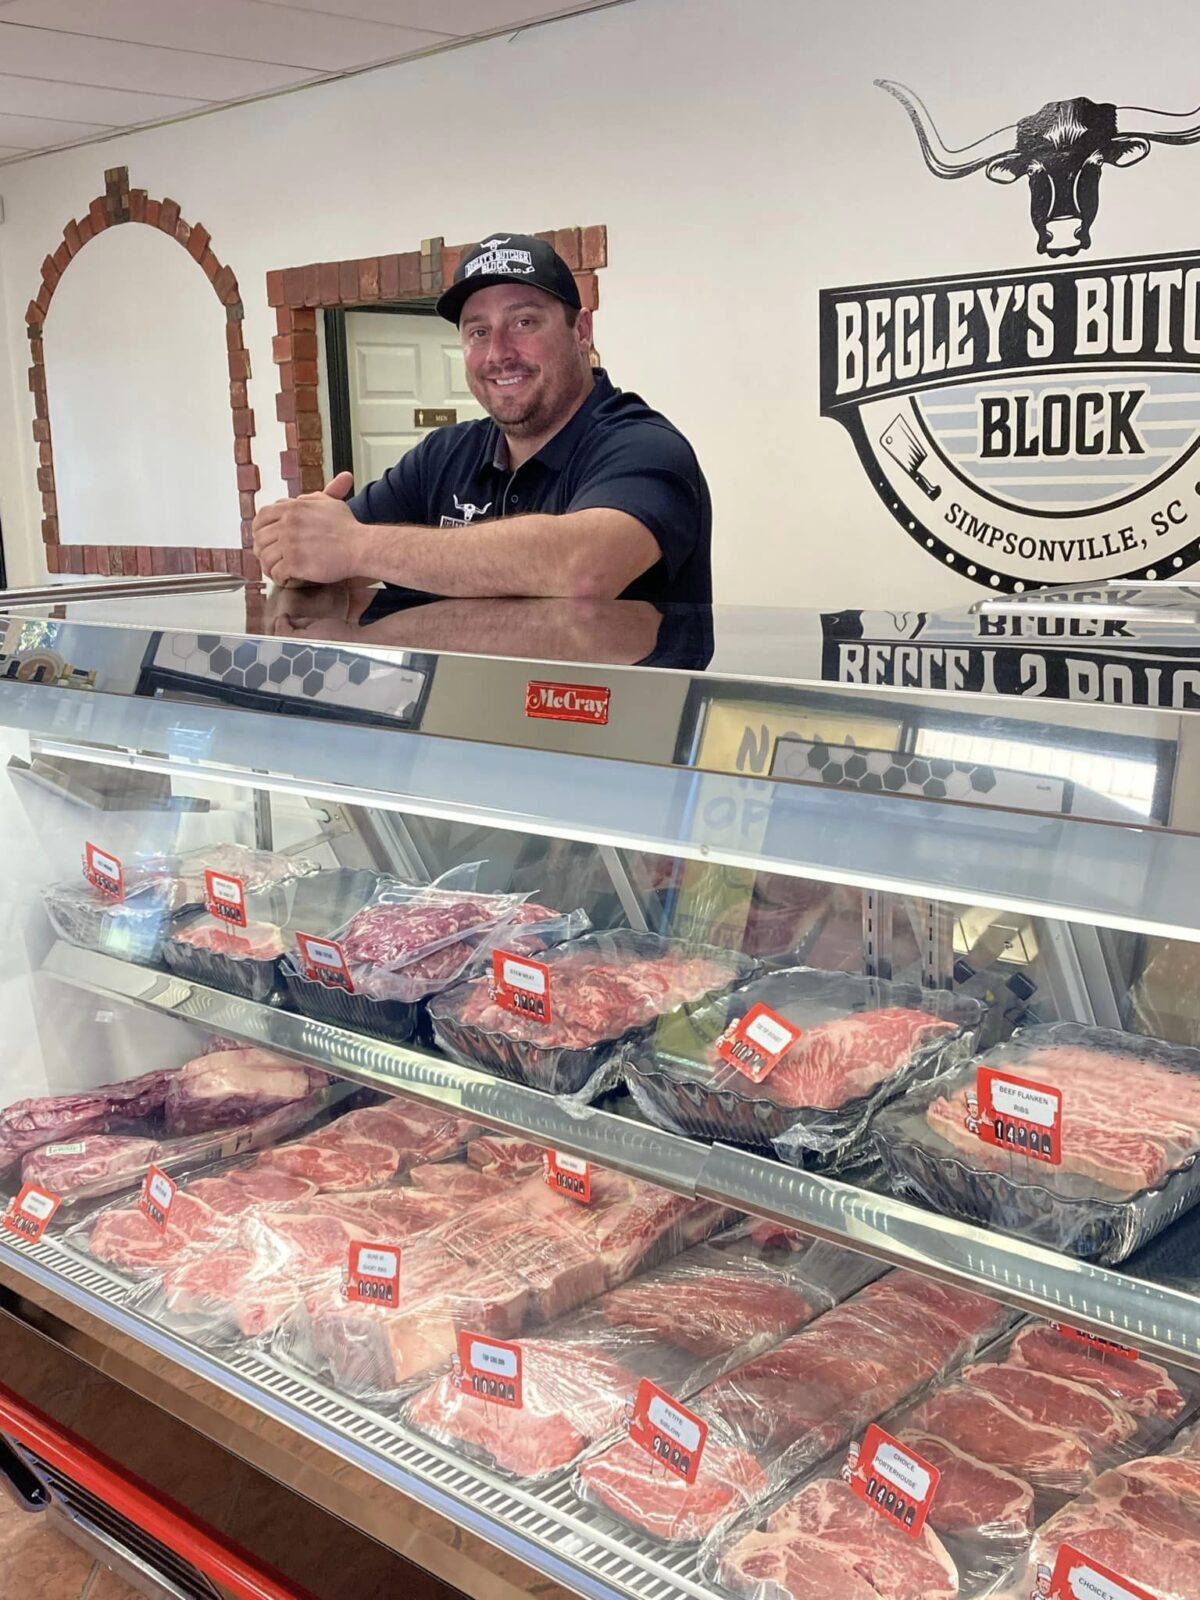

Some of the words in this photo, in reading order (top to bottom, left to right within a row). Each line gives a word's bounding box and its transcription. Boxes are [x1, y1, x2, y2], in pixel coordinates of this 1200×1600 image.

[835, 282, 1054, 396] BEGLEY'S
[980, 390, 1146, 459] BLOCK
[944, 502, 1148, 562] SIMPSONVILLE,
[1150, 500, 1189, 537] SC
[528, 688, 606, 718] McCray
[999, 1085, 1017, 1097] BEEF
[1017, 1090, 1049, 1105] FLANKEN
[1013, 1104, 1030, 1115] RIBS
[875, 1455, 918, 1490] PORTERHOUSE
[893, 1452, 916, 1473] CHOICE
[1078, 1577, 1108, 1599] CHOICE
